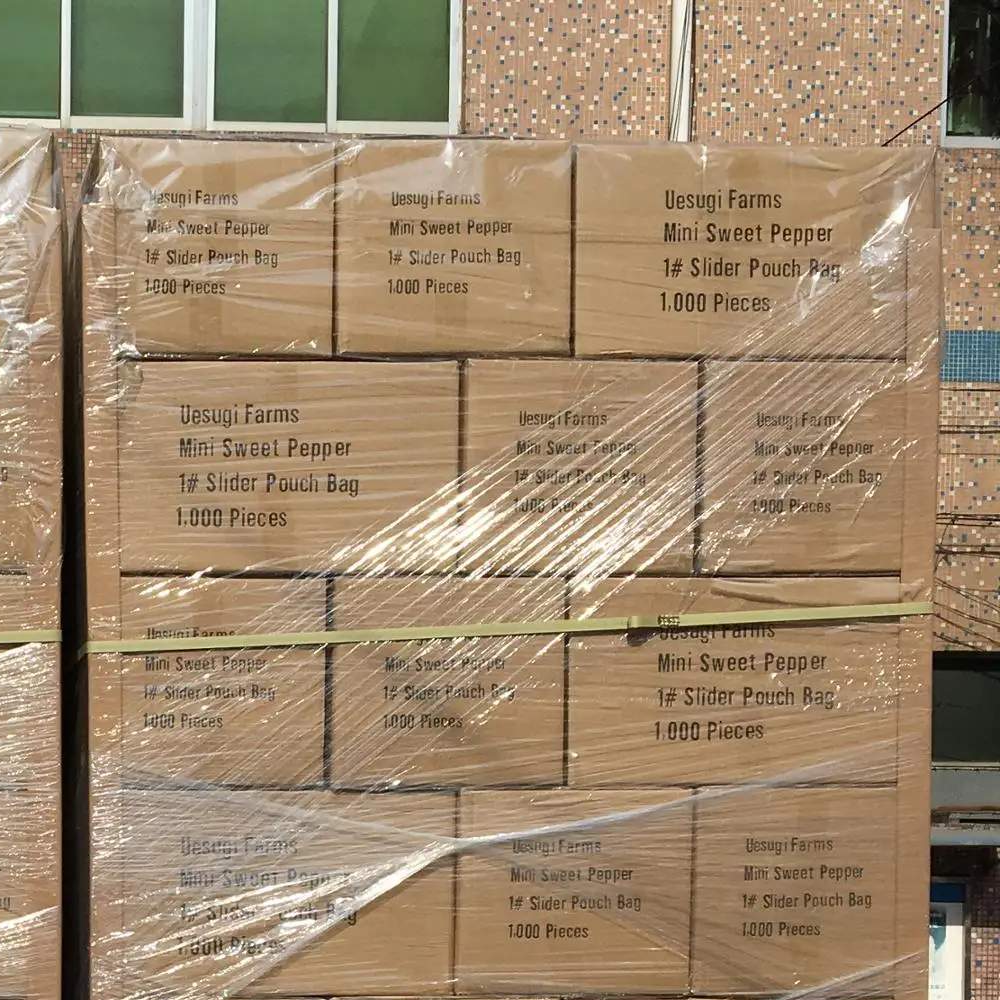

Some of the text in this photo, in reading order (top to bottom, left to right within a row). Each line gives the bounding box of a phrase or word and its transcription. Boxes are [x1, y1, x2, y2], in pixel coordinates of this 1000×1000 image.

[391, 191, 481, 209] Uesugi Farms
[665, 189, 782, 213] Uesugi Farms
[389, 220, 512, 236] Mini Sweet Pepper
[664, 222, 833, 246] Mini Sweet Pepper
[388, 250, 521, 266] 1# Slider Pouch Bag
[663, 258, 683, 277] 1#
[691, 258, 741, 277] Slider
[750, 259, 800, 277] Pouch
[425, 279, 468, 294] Pieces
[714, 292, 770, 312] Pieces
[180, 404, 299, 428] Uesugi Farms
[179, 437, 351, 461] Mini Sweet Pepper
[178, 472, 359, 497] 1# Slider Pouch Bag
[230, 507, 288, 527] Pieces
[658, 652, 826, 675] Mini Sweet Pepper
[657, 687, 834, 709] 1# Slider Pouch Bag
[707, 721, 764, 740] Pieces
[746, 838, 833, 855] Uesugi Farms
[744, 865, 864, 881] Mini Sweet Pepper
[742, 894, 872, 910] 1# Slider Pouch Bag
[779, 922, 820, 936] Pieces
